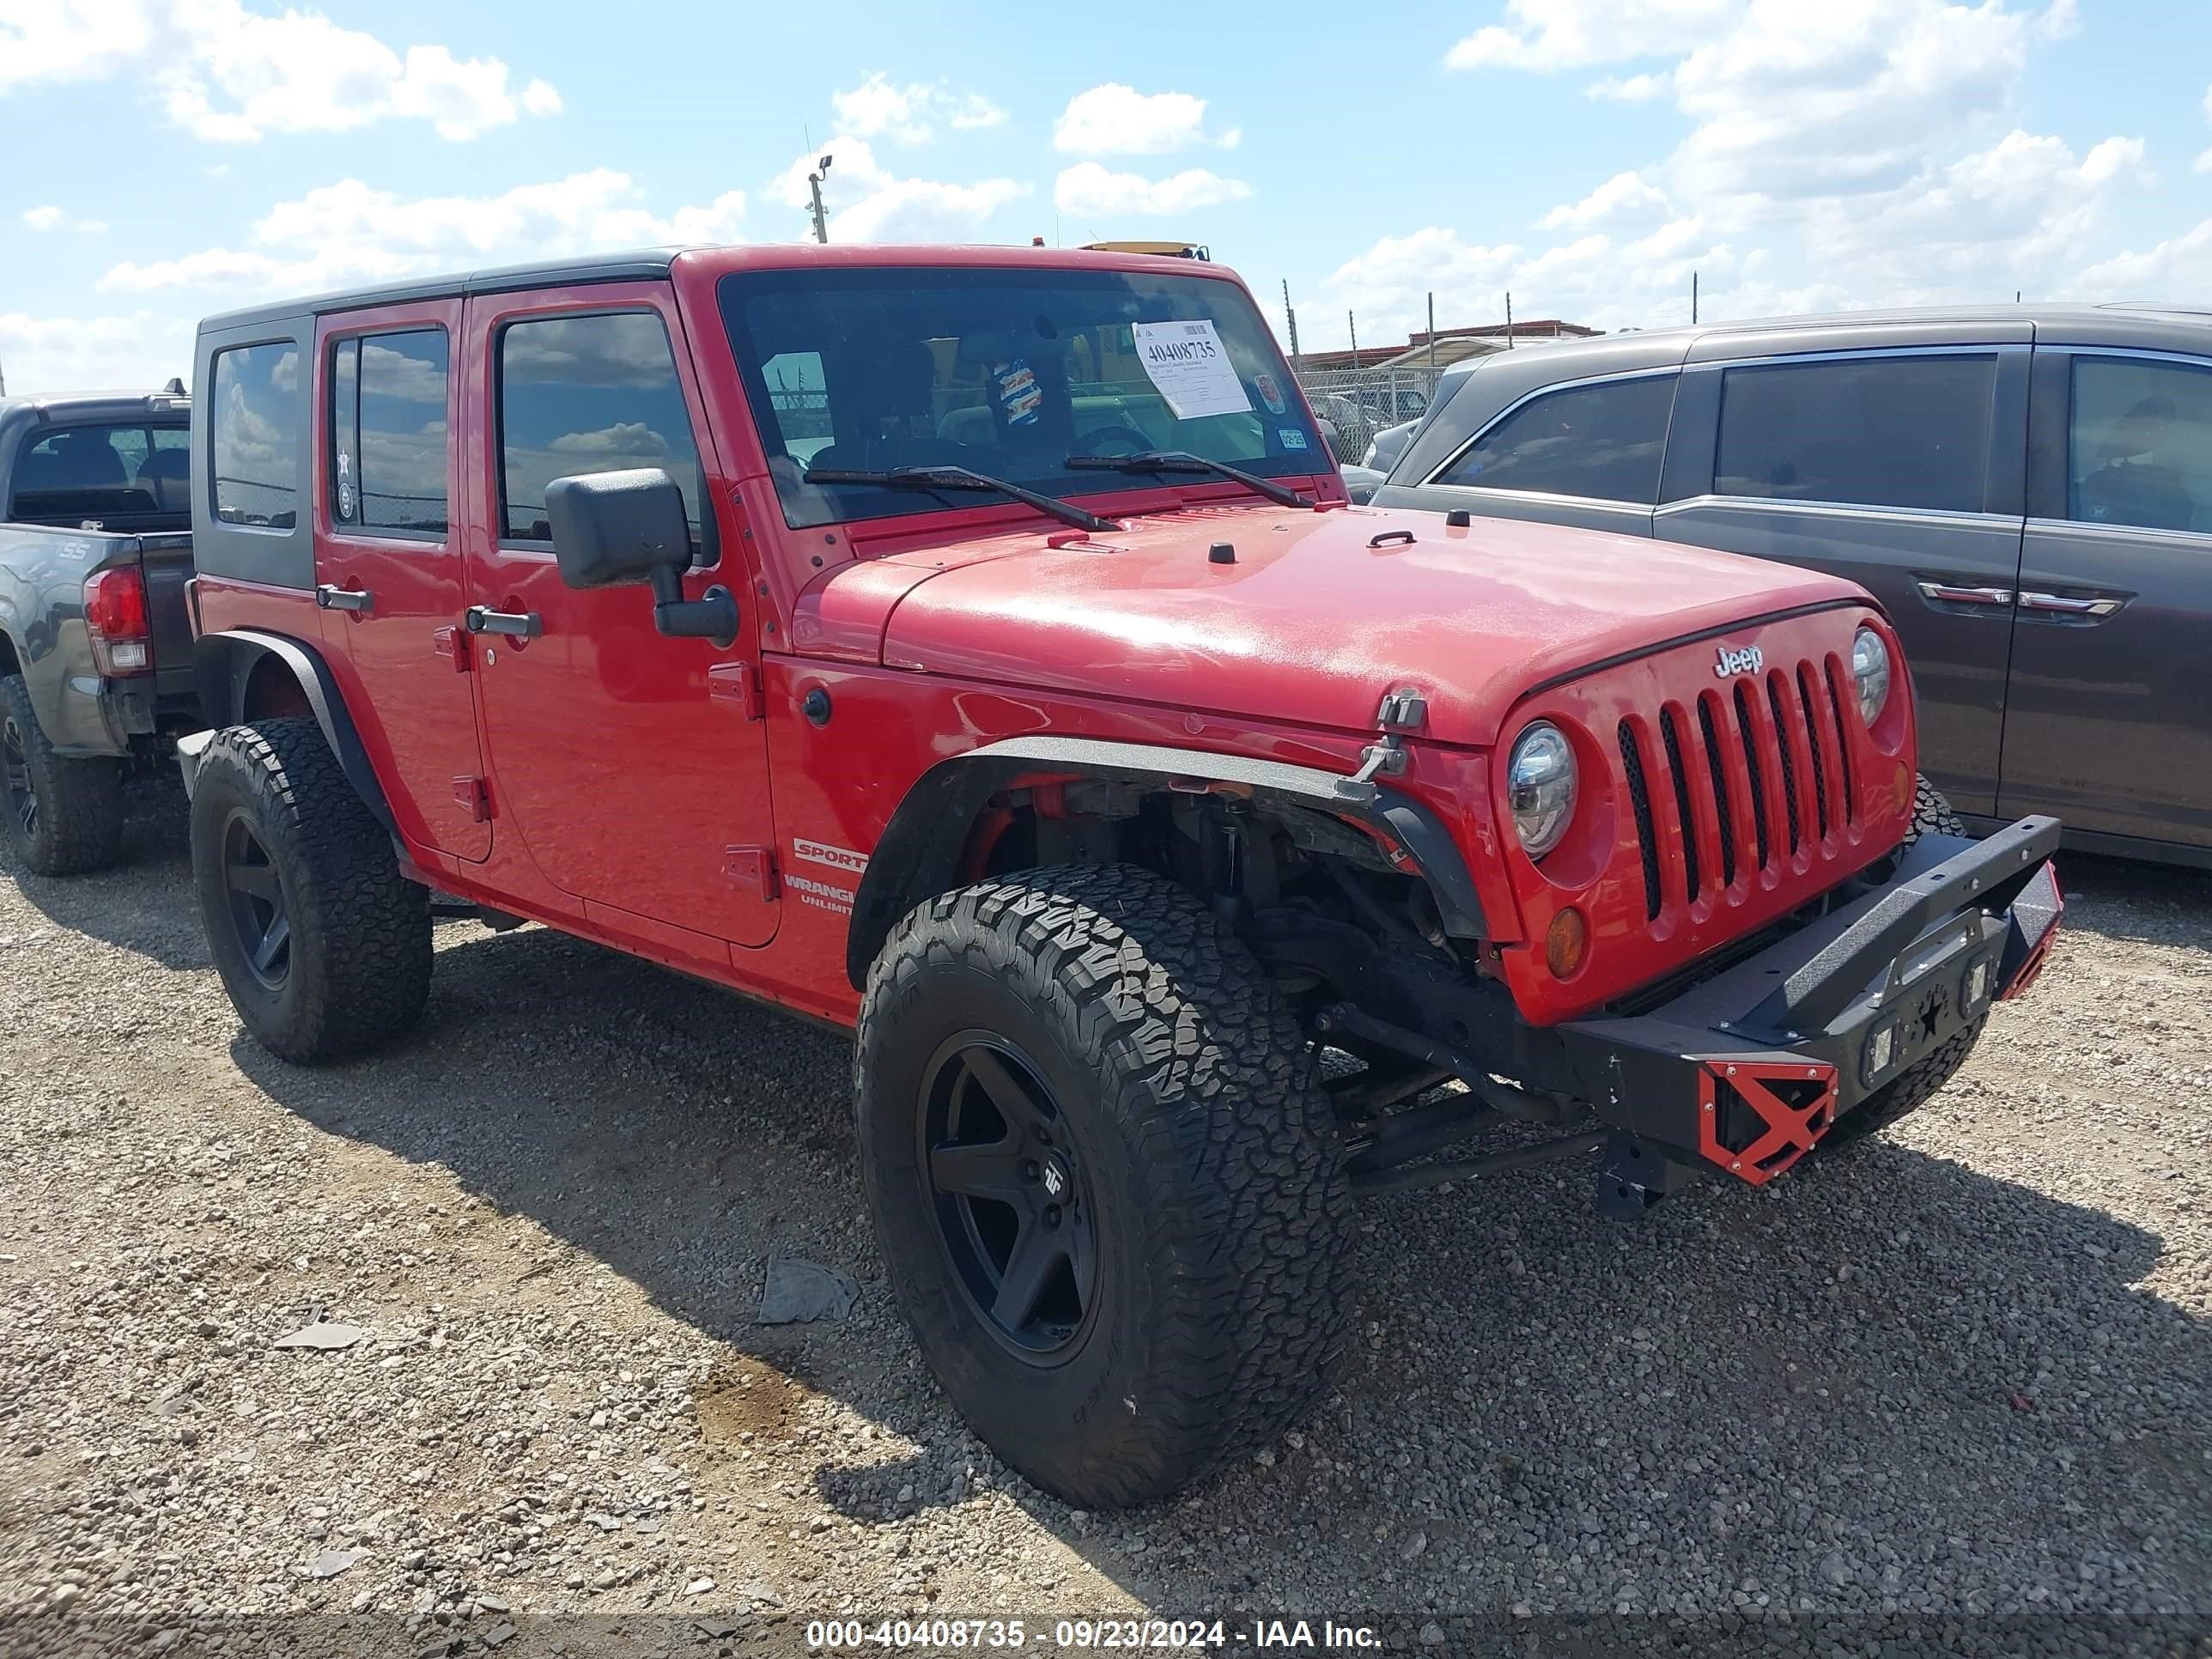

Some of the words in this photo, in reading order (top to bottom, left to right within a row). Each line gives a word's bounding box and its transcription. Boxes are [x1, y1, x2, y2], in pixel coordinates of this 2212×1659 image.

[1148, 341, 1216, 362] 40408735
[1714, 645, 1764, 678] Jeep
[798, 843, 869, 868] SPORT
